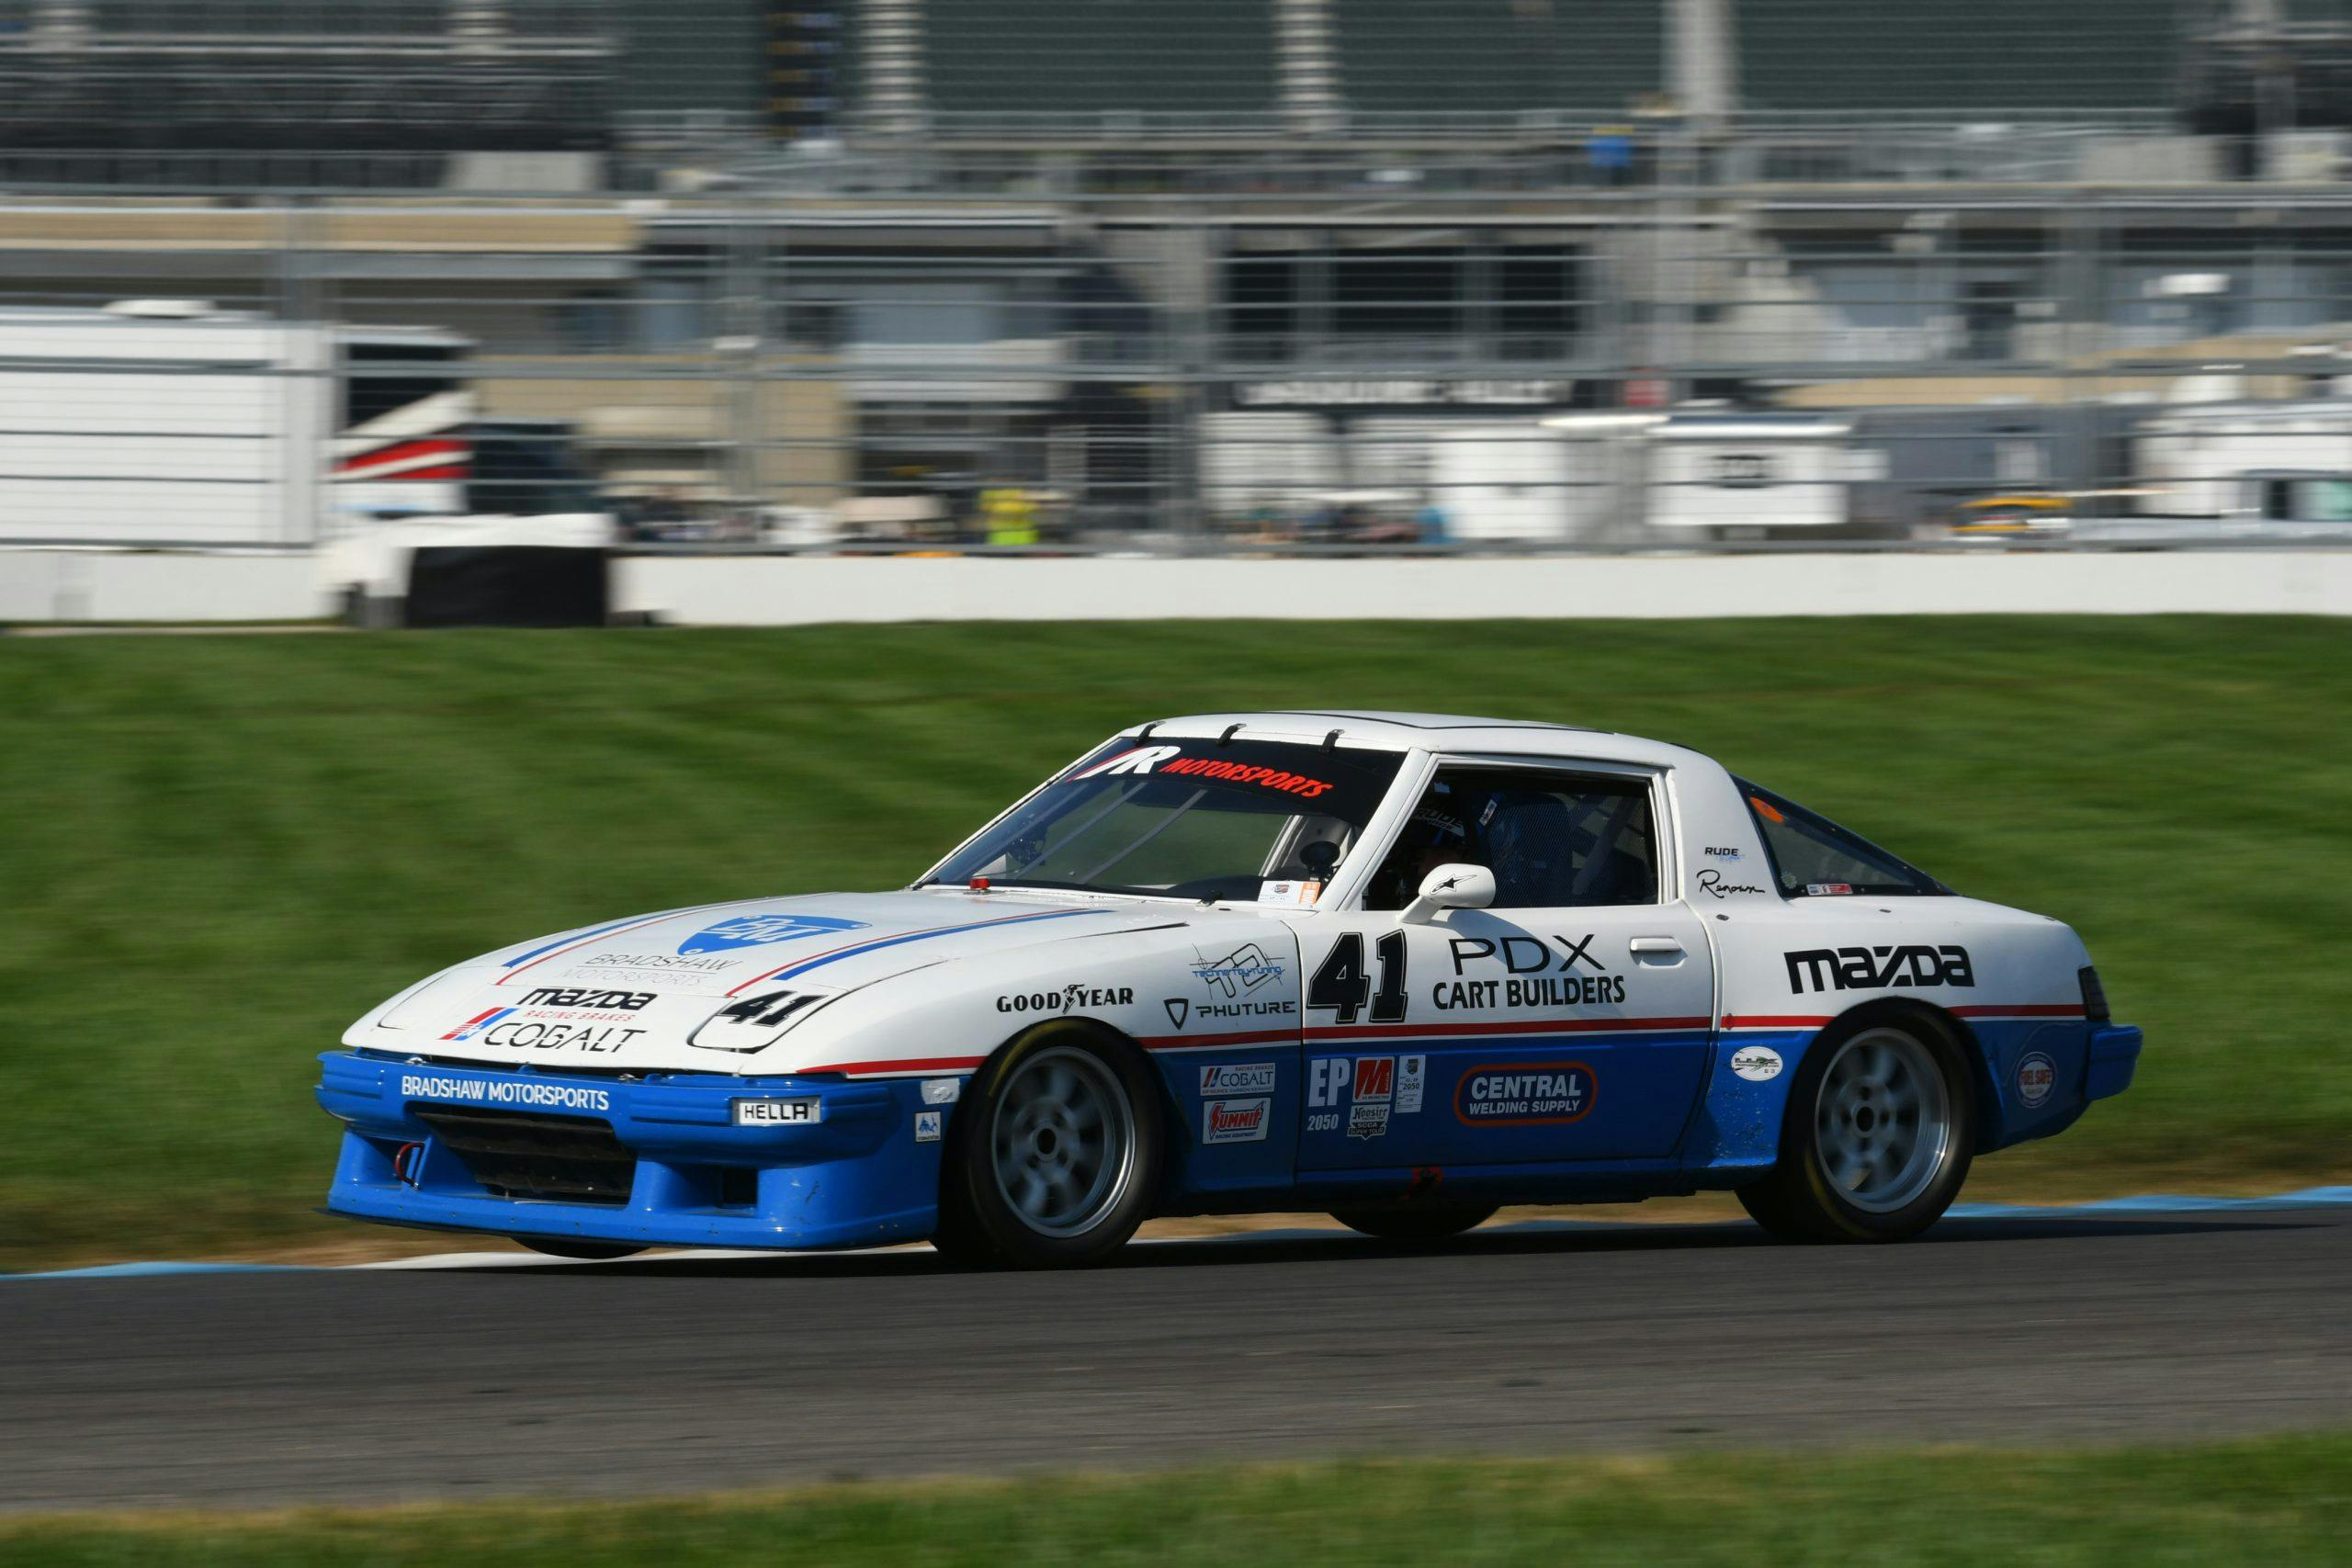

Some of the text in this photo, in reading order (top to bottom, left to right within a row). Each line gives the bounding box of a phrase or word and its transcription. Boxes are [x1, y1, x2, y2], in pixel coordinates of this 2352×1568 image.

[1158, 758, 1334, 797] MOTORSPORTS
[1704, 846, 1738, 856] RUDE
[584, 953, 743, 971] BRADSHAW
[1448, 933, 1606, 976] PDX
[560, 967, 707, 986] MOTORSPORTS
[1305, 929, 1408, 1024] 41
[1432, 975, 1626, 1010] CART BUILDERS
[523, 1010, 637, 1022] RACING BRAKES
[717, 989, 829, 1026] 41
[1195, 1000, 1296, 1018] PHUTURE
[483, 1022, 648, 1054] COBALT
[1220, 1071, 1274, 1088] COBALT
[1307, 1058, 1351, 1107] EP
[1471, 1075, 1581, 1100] CENTRAL
[401, 1076, 610, 1111] BRADSHAW MOTORSPORTS
[743, 1102, 809, 1121] HELLA
[1469, 1100, 1580, 1115] WELDING SUPPLY
[1306, 1114, 1340, 1131] 2050
